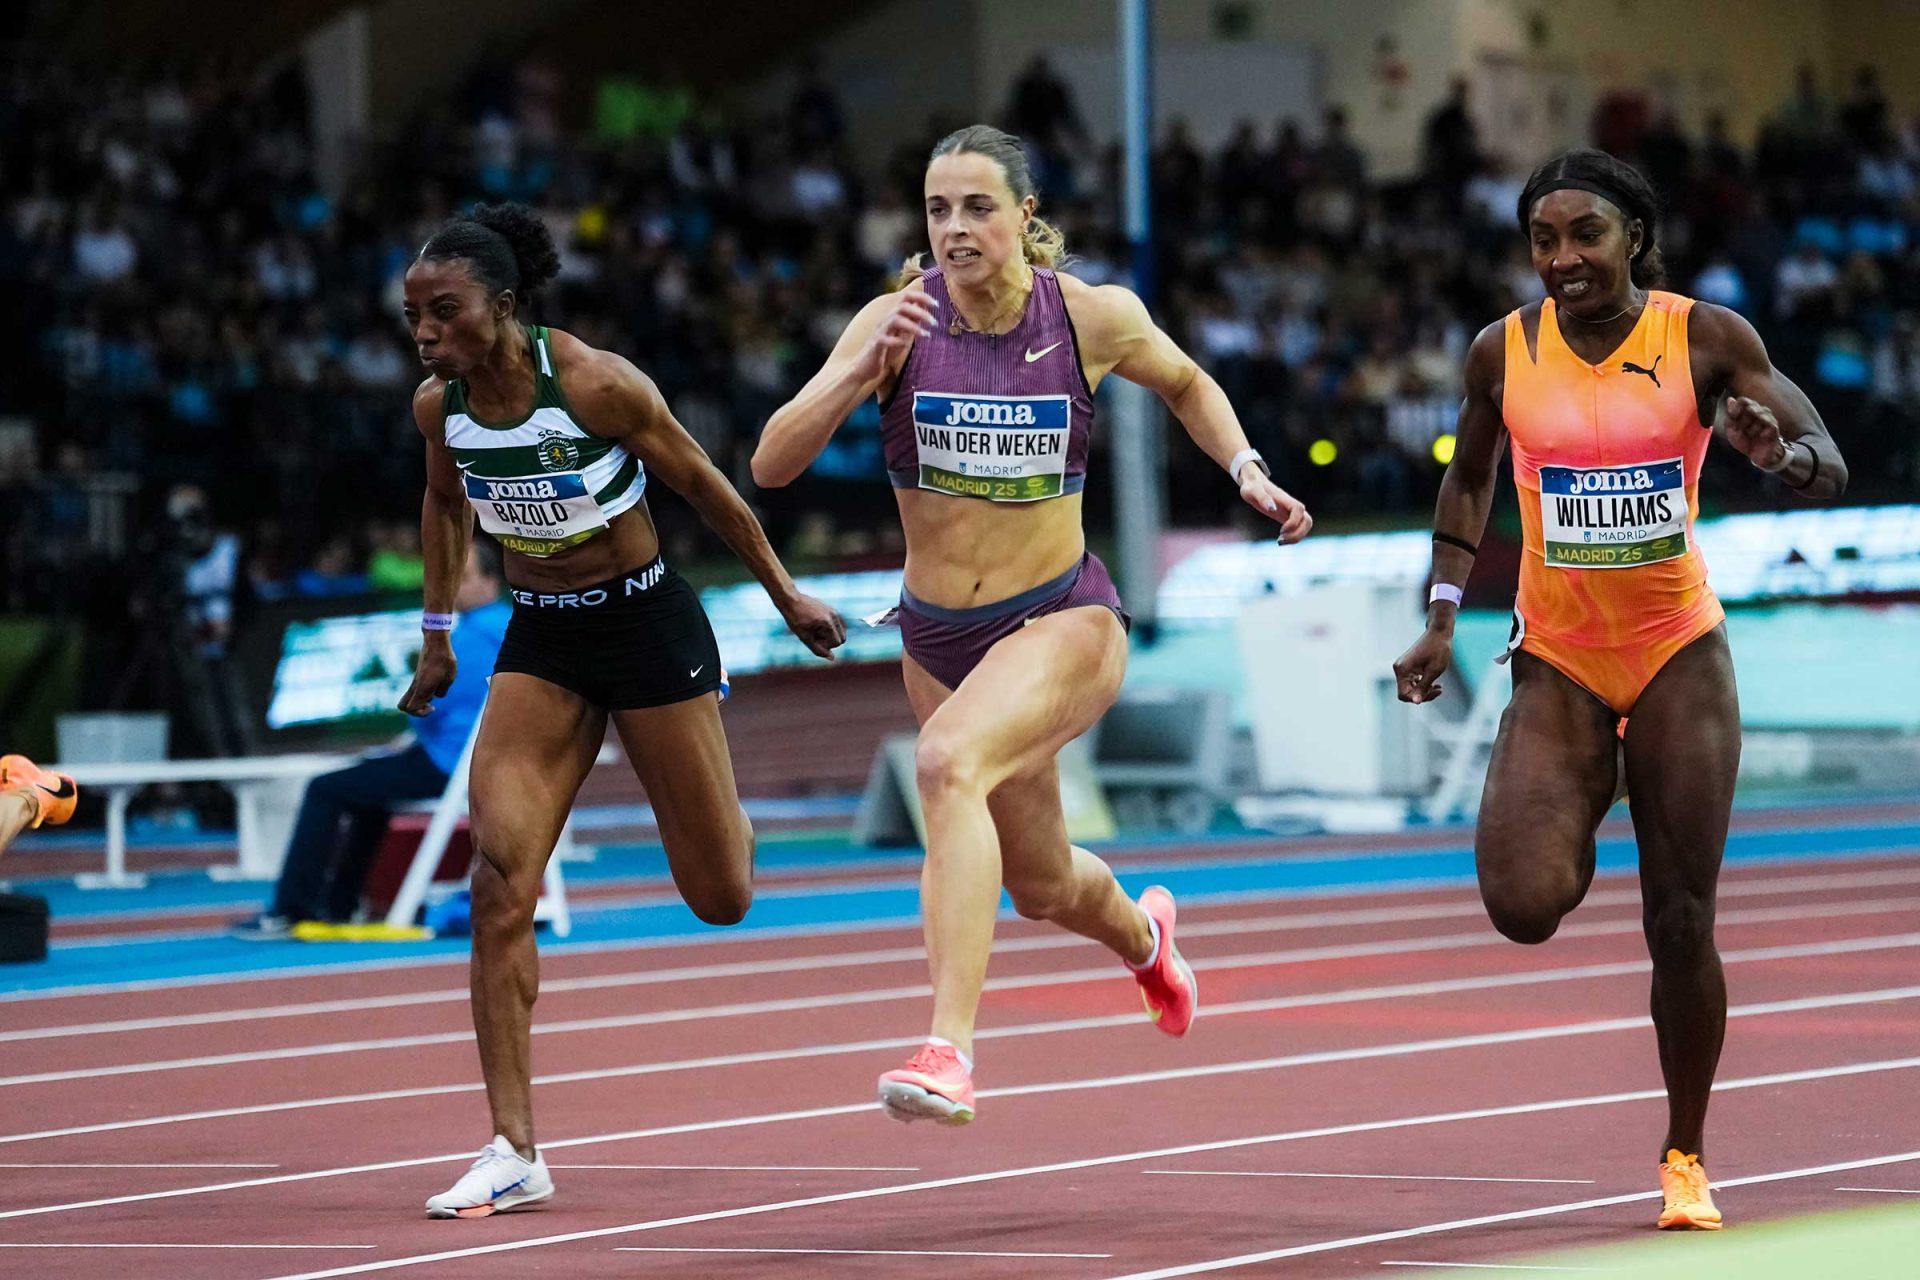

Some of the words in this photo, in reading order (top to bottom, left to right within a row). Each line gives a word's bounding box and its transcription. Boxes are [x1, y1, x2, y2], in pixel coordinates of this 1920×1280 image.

[540, 438, 570, 451] SPORTING
[917, 426, 950, 451] VAN
[956, 431, 991, 456] DER
[996, 433, 1061, 456] WEKEN
[974, 464, 1022, 475] MADRID
[931, 472, 991, 496] MADRID
[994, 482, 1017, 497] 25
[492, 502, 569, 527] BAZOLO
[1556, 492, 1673, 528] WILLIAMS
[525, 528, 565, 538] MADRID
[1598, 530, 1648, 542] MADRID
[1556, 547, 1616, 562] MADRID
[1620, 547, 1643, 562] 25
[538, 589, 608, 609] PRO
